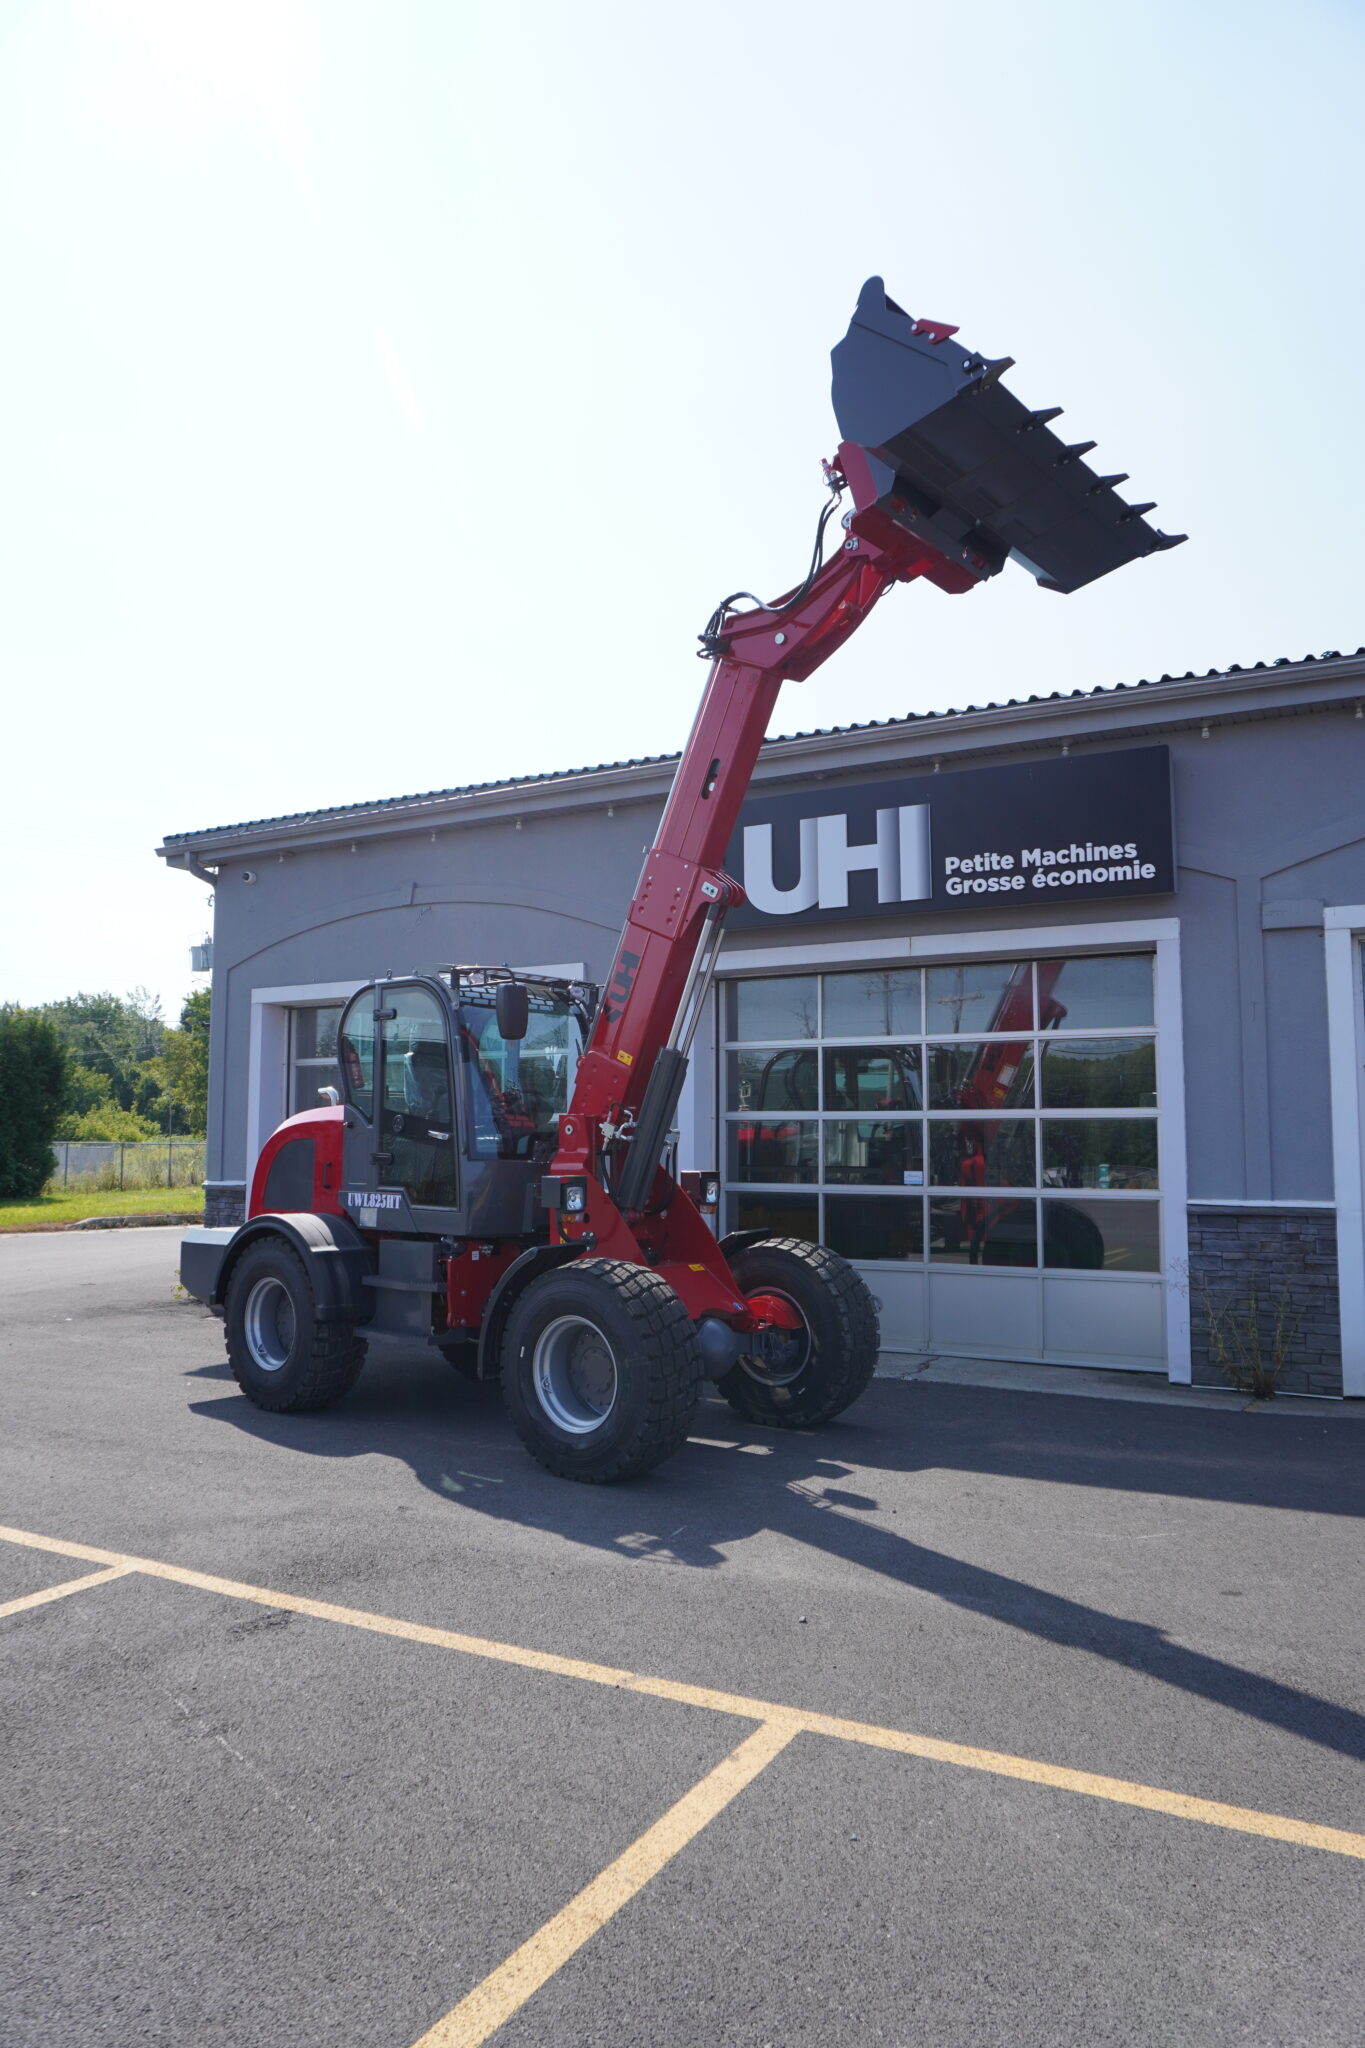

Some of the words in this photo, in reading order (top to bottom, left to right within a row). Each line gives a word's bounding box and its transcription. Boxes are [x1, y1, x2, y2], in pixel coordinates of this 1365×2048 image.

[744, 803, 932, 914] UHI
[945, 852, 1014, 875] Petite
[1021, 842, 1137, 868] Machines
[945, 875, 1026, 896] Grosse
[1032, 860, 1156, 888] économie
[347, 1192, 402, 1209] UWL825HT
